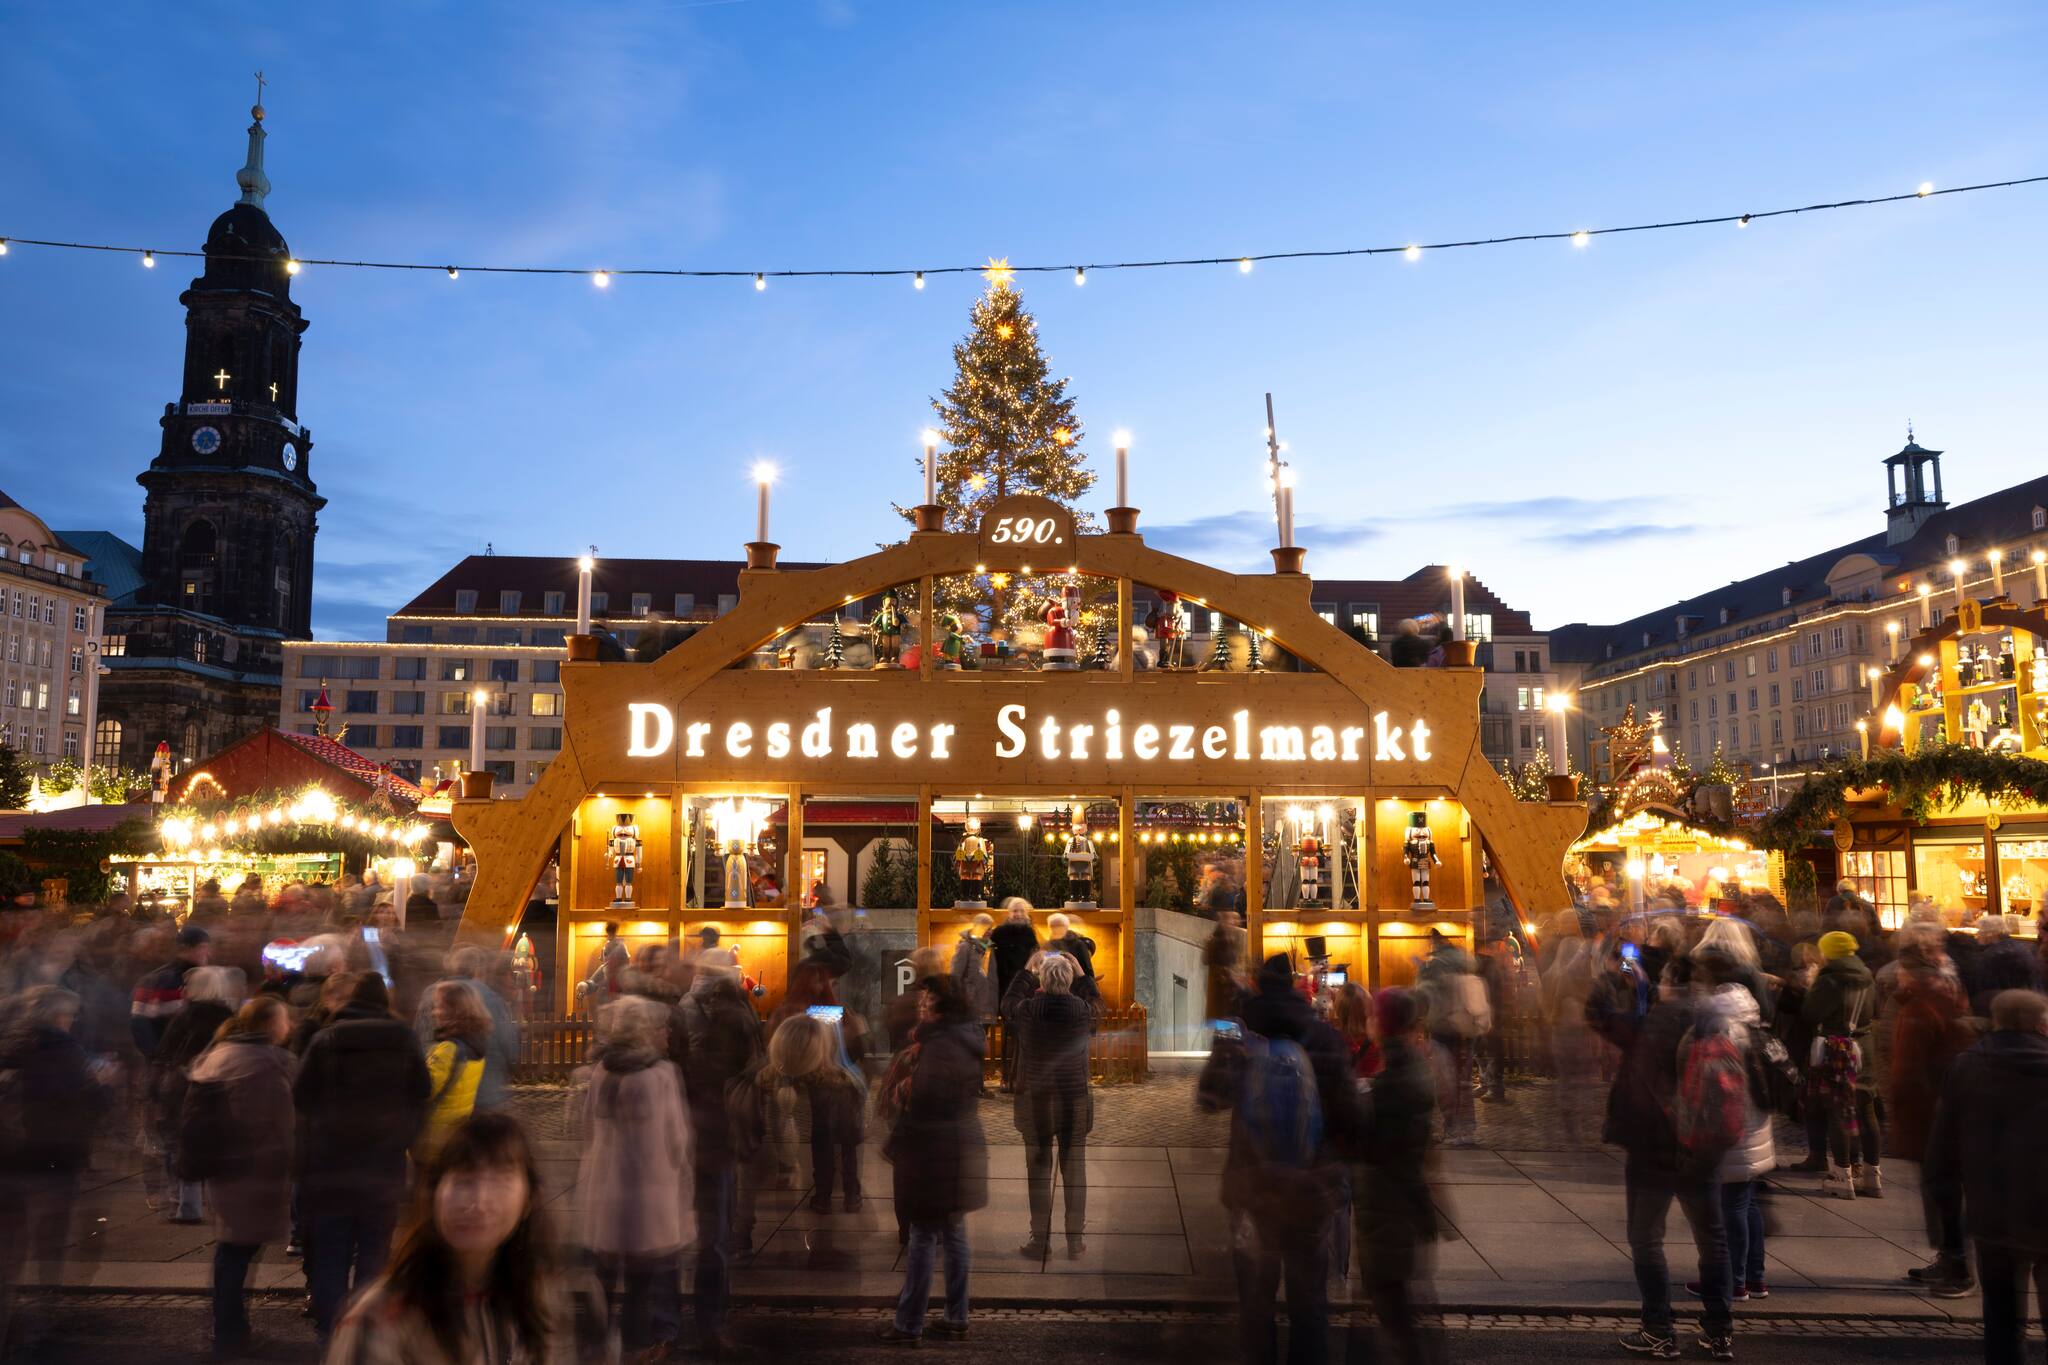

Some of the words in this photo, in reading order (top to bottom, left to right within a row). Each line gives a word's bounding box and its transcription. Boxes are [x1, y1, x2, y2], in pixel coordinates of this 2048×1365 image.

[992, 517, 1062, 544] 590.
[627, 702, 955, 759] Dresdner
[995, 703, 1432, 761] Striezelmarkt
[897, 965, 916, 996] P
